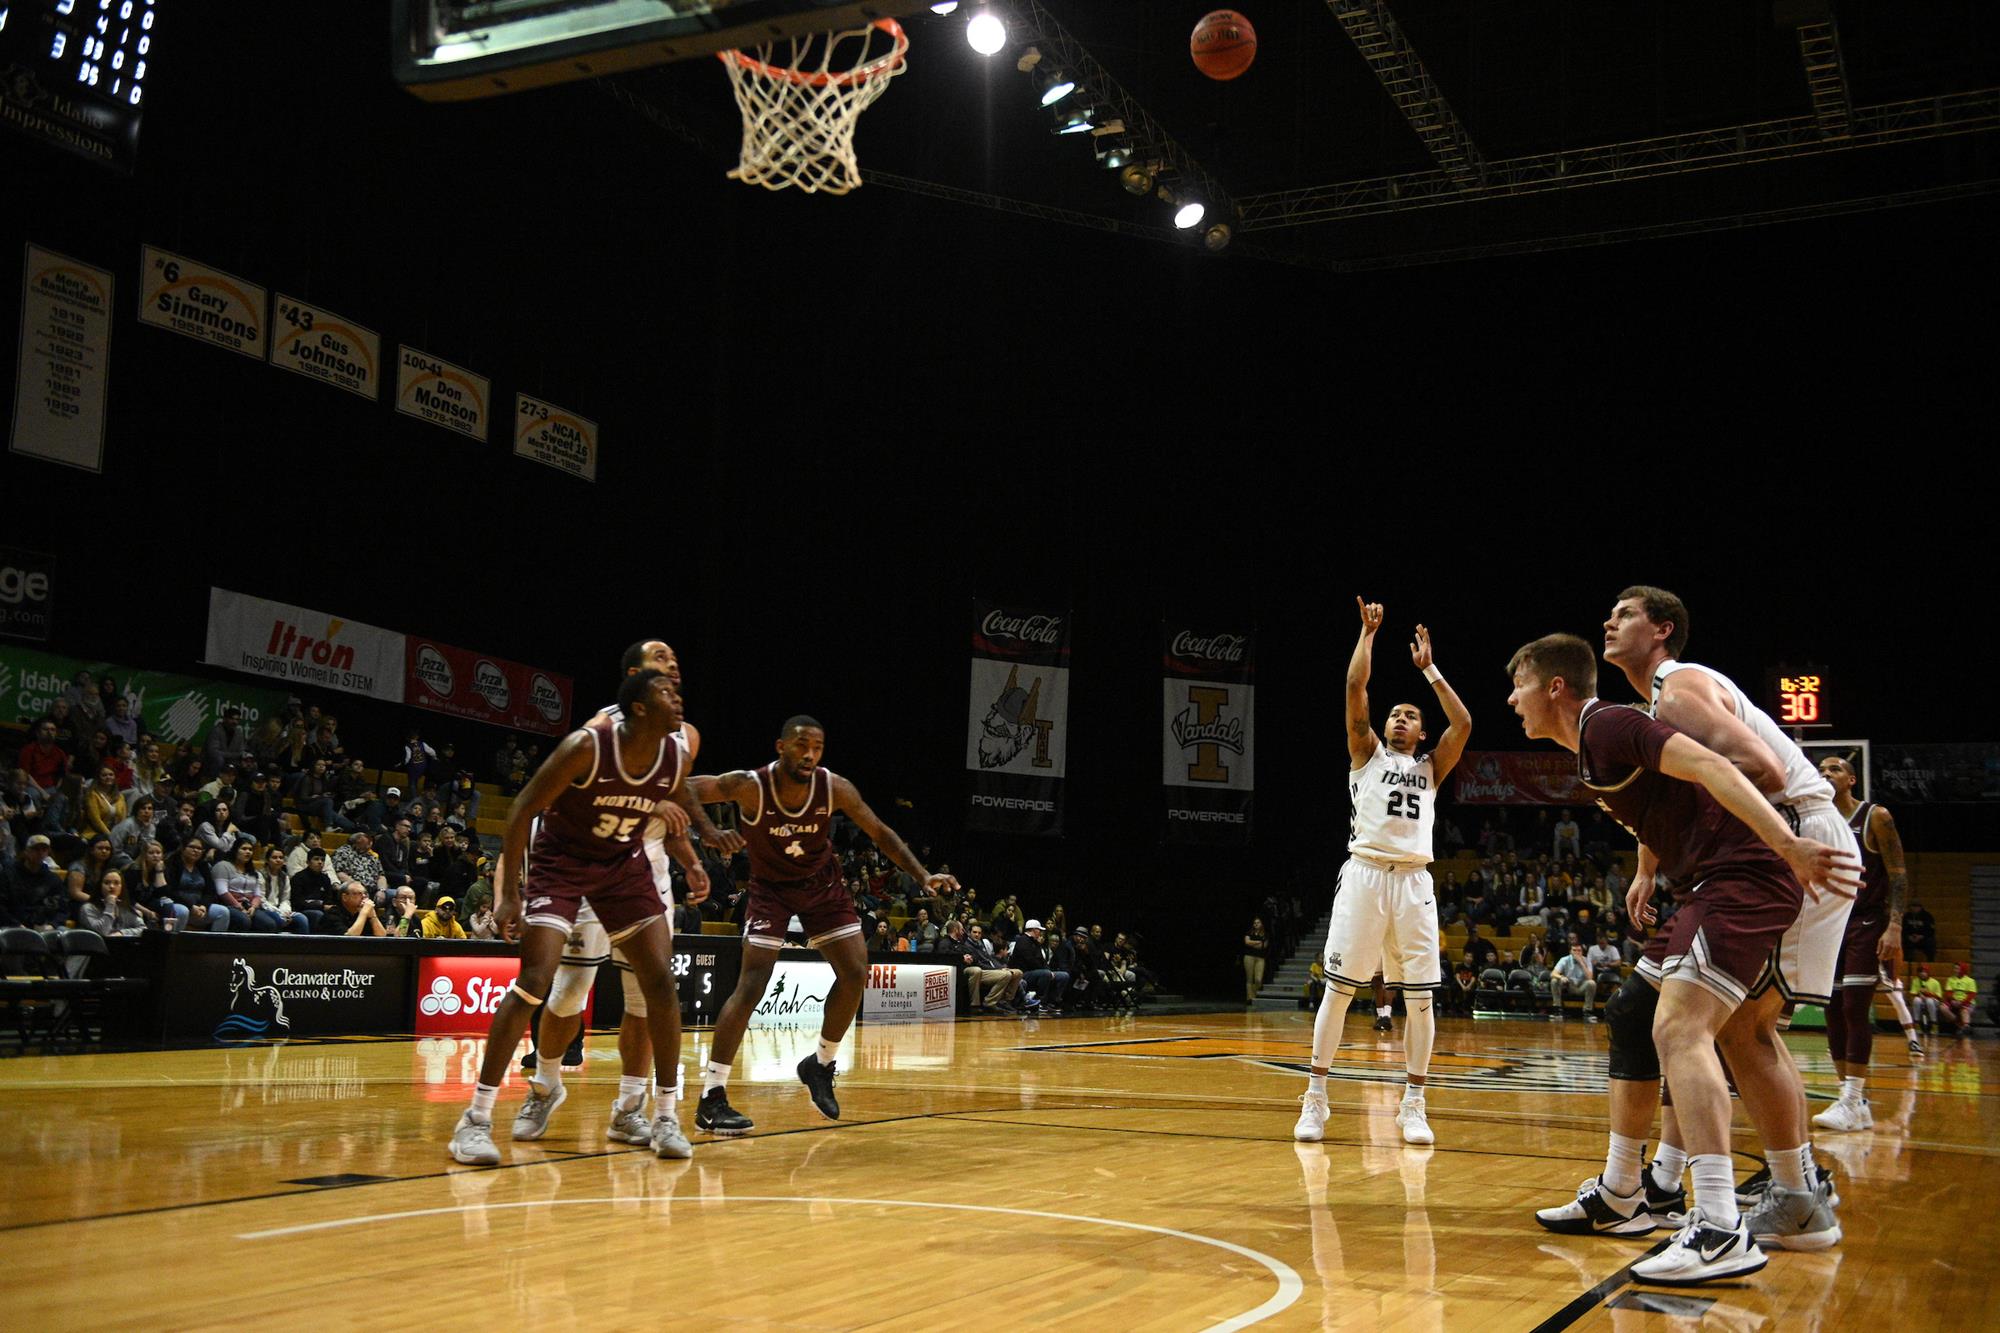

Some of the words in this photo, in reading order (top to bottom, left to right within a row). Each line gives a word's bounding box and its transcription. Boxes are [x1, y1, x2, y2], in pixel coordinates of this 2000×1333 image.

[41, 277, 101, 305] Basketball
[189, 286, 228, 313] Gary
[158, 292, 257, 341] Simmons
[280, 304, 313, 331] #43
[321, 334, 348, 355] Gus
[290, 339, 366, 381] Johnson
[403, 354, 442, 377] 100-41
[437, 381, 462, 401] Don
[415, 387, 477, 424] Monson
[520, 401, 548, 420] 27-3
[541, 430, 573, 451] Sweet
[576, 443, 588, 457] 16
[552, 422, 580, 444] NCAA
[267, 620, 355, 671] Itron
[242, 651, 288, 678] Inspiring
[291, 661, 327, 683] Women
[343, 672, 374, 696] STEM
[535, 686, 556, 699] PIZZA
[1781, 693, 1817, 721] 30
[1171, 707, 1244, 756] Vandals
[1382, 770, 1427, 790] IDAHO
[1460, 778, 1516, 800] Wendy's
[971, 795, 1056, 812] POWERADE
[1388, 791, 1420, 819] 25
[592, 813, 641, 842] 35
[1168, 809, 1246, 824] POWERADE
[696, 954, 715, 966] GUEST
[272, 967, 341, 987] Clearwater
[342, 968, 376, 988] River
[704, 973, 712, 993] 5
[865, 965, 897, 989] FREE
[925, 974, 949, 987] PROJECT
[282, 989, 319, 1000] CASINO
[320, 987, 331, 1001] &
[333, 989, 365, 1000] LODGE
[881, 990, 905, 999] Patches,
[907, 990, 918, 1000] gum
[890, 1000, 912, 1009] lozenges
[925, 986, 949, 1001] FILTER
